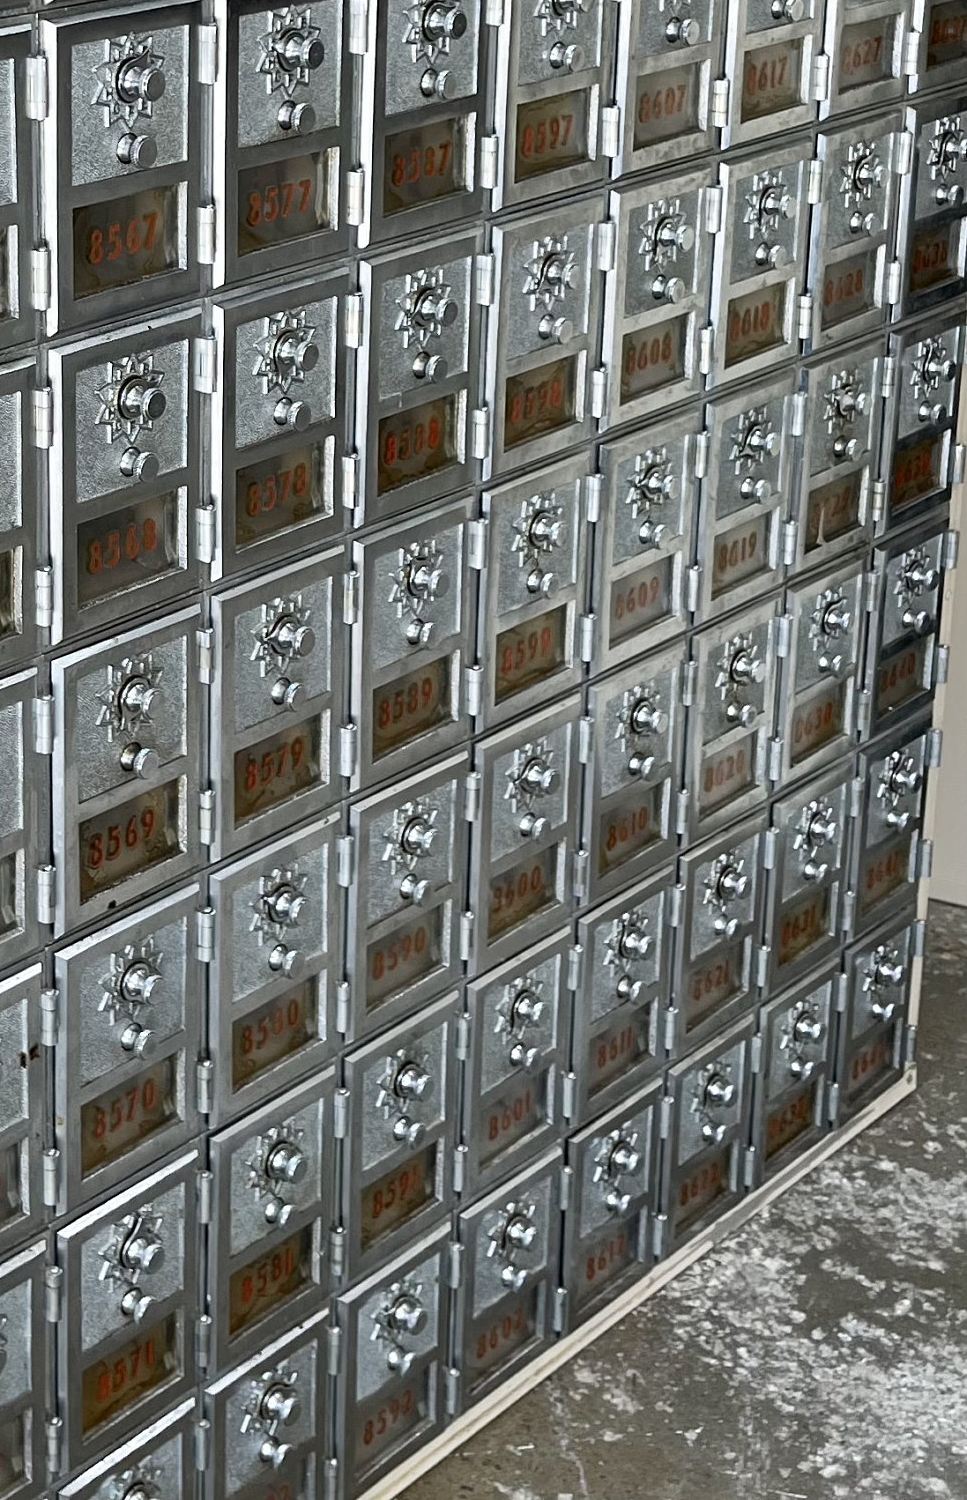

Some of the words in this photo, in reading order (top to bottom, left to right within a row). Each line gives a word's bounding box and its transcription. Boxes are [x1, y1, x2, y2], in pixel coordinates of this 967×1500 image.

[391, 140, 452, 188] 8587
[247, 178, 314, 227] 8577
[90, 214, 158, 265] 8567
[382, 417, 440, 467] 8588
[245, 462, 310, 516] 8578
[88, 517, 157, 576] 8568
[378, 677, 433, 729] 8589
[243, 738, 304, 791] 8579
[90, 807, 154, 870] 8569
[371, 925, 426, 982] 8590
[241, 1001, 301, 1053] 8580
[94, 1077, 159, 1141] 8570
[371, 1162, 421, 1220] 8591
[241, 1248, 294, 1302] 8581
[97, 1342, 155, 1402] 8571
[362, 1388, 415, 1447] 8592
